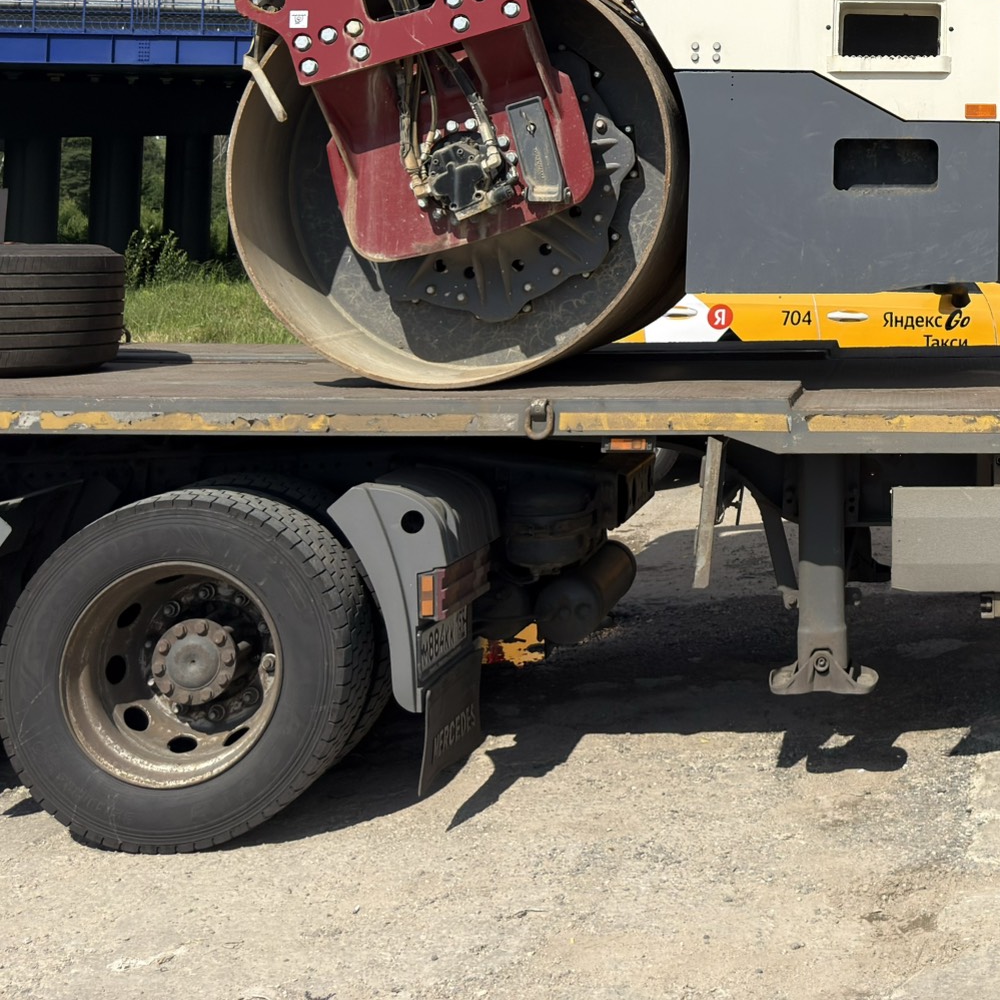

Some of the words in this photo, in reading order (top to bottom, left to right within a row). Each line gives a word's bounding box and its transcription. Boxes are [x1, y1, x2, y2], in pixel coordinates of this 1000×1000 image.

[713, 308, 726, 326] Я
[782, 310, 812, 326] 704
[883, 311, 943, 330] Яндекс
[945, 309, 971, 331] Go
[923, 334, 968, 347] Такси
[430, 703, 477, 764] MERCEDES
